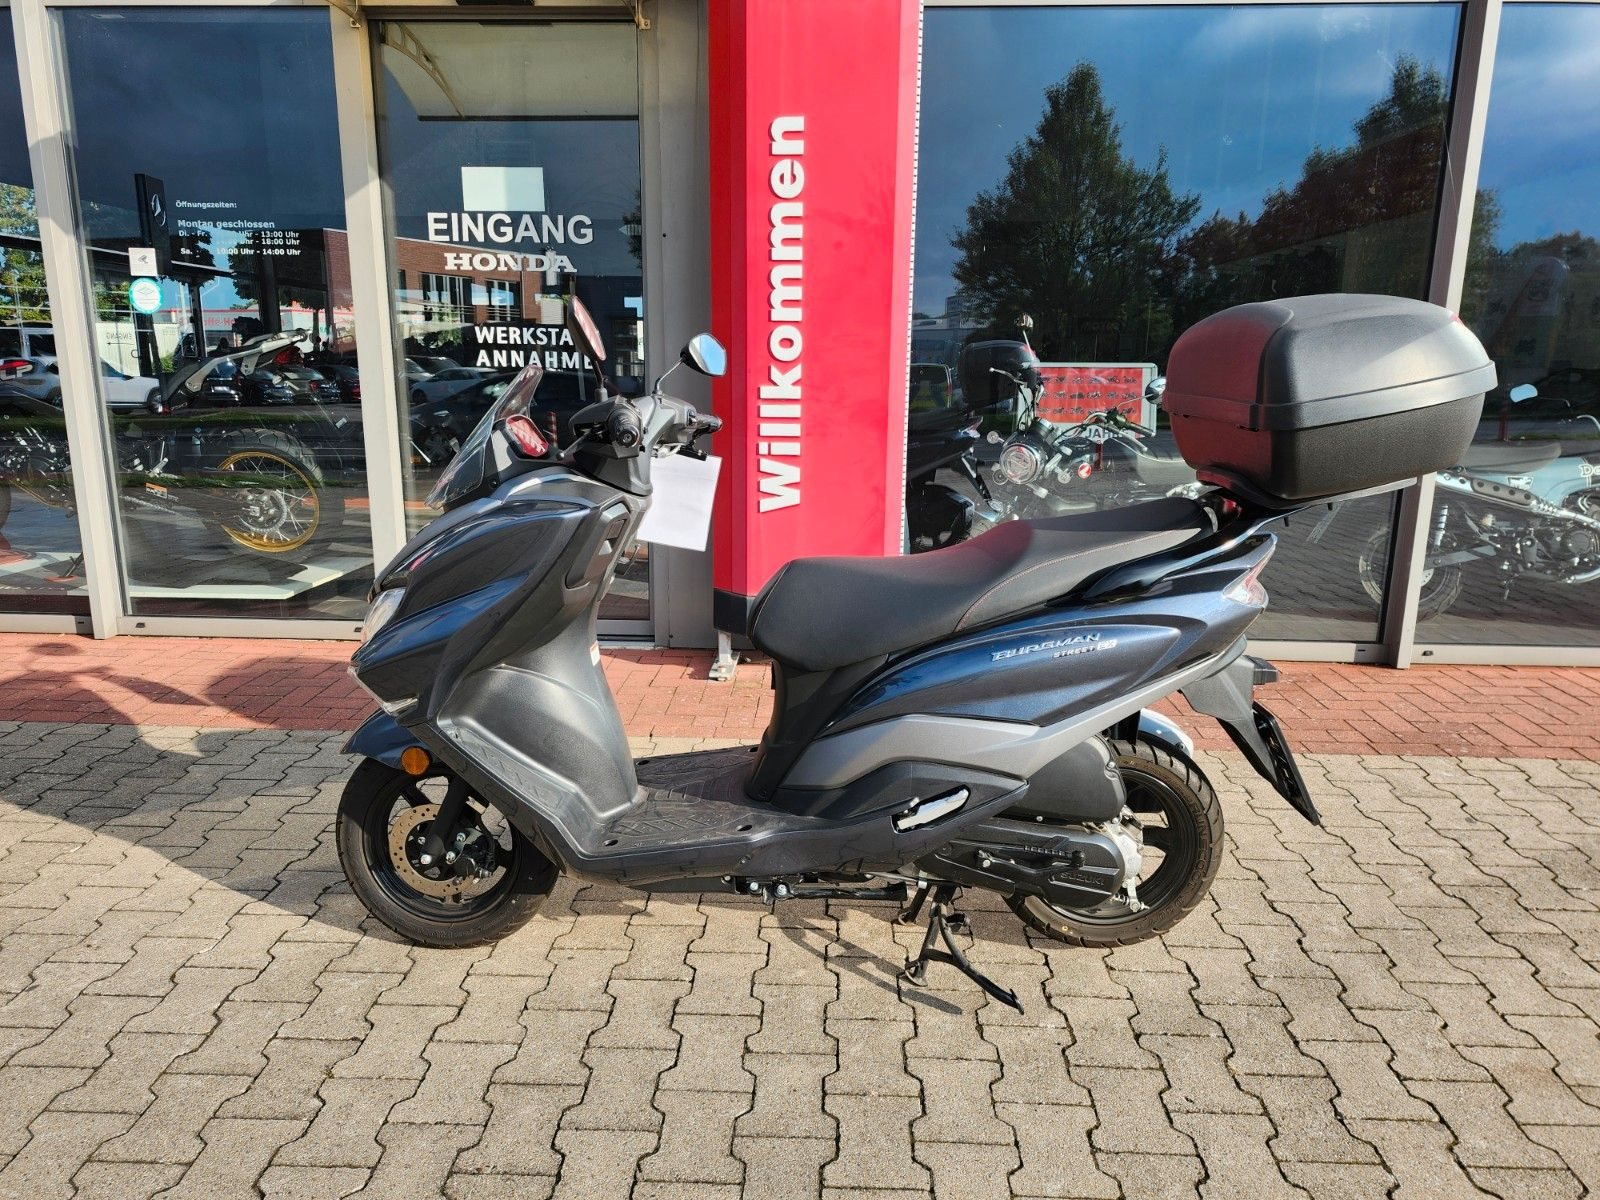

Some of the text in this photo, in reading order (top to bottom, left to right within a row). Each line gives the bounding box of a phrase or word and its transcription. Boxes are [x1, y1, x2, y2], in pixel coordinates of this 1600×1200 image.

[175, 200, 237, 209] Öffnungszeiten:
[216, 220, 275, 230] geschlossen
[427, 212, 594, 245] EINGANG
[286, 238, 300, 246] Uhr
[262, 248, 285, 256] 14:00
[443, 252, 578, 273] HONDA
[757, 115, 805, 513] Willkommen
[474, 326, 573, 346] WERKSTA
[991, 632, 1100, 661] BURGMAN
[1053, 645, 1096, 658] STREET
